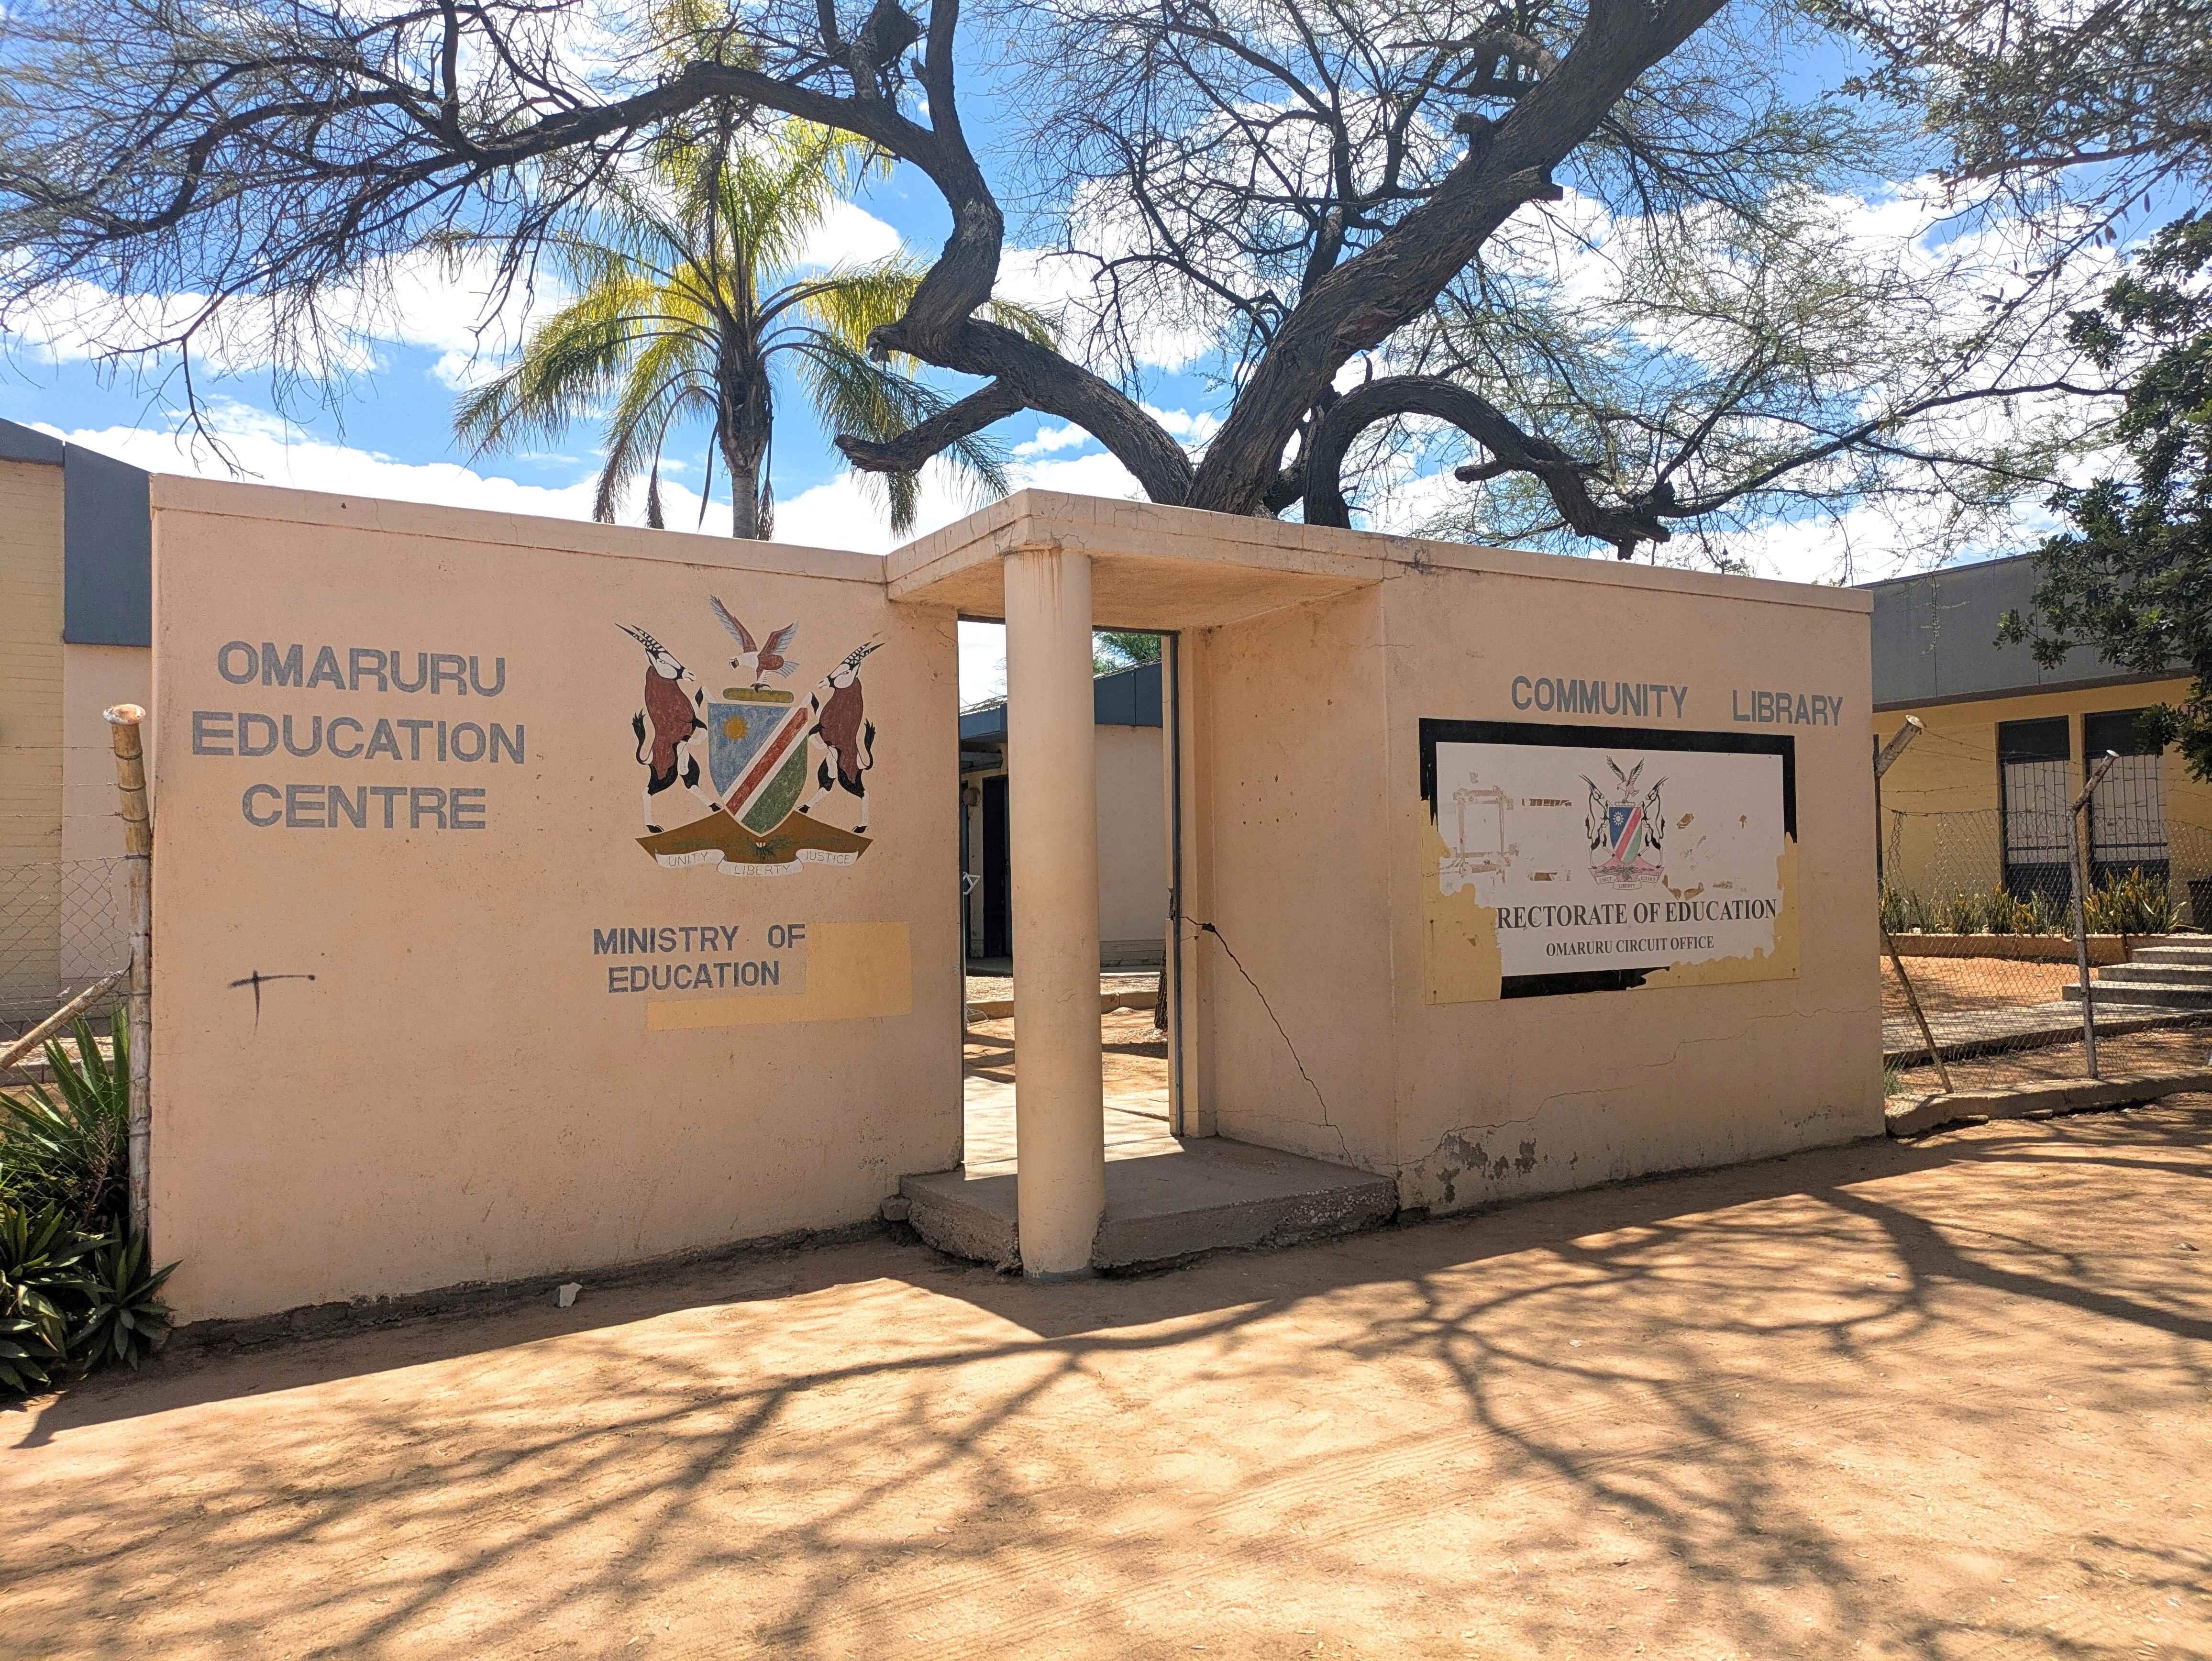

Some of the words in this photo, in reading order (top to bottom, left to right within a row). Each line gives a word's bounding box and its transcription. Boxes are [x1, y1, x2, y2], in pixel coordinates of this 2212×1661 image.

[218, 641, 505, 697] OMARURU
[1511, 675, 1688, 718] COMMUNITY
[1733, 690, 1843, 726] LIBRARY
[192, 711, 525, 764] EDUCATION
[242, 784, 486, 829] CENTRE
[668, 852, 708, 866] UNITY
[734, 865, 791, 875] LIBERTY
[806, 851, 850, 864] JUSTICE
[1496, 904, 1627, 929] RECTORATE
[1633, 902, 1660, 923] OF
[1665, 899, 1777, 922] EDUCATION
[593, 925, 740, 955] MINISTRY
[767, 923, 806, 949] OF
[1546, 941, 1613, 956] OMARURU
[1616, 938, 1667, 953] CIRCUIT
[1670, 936, 1714, 950] OFFICE
[608, 960, 779, 993] EDUCATION
